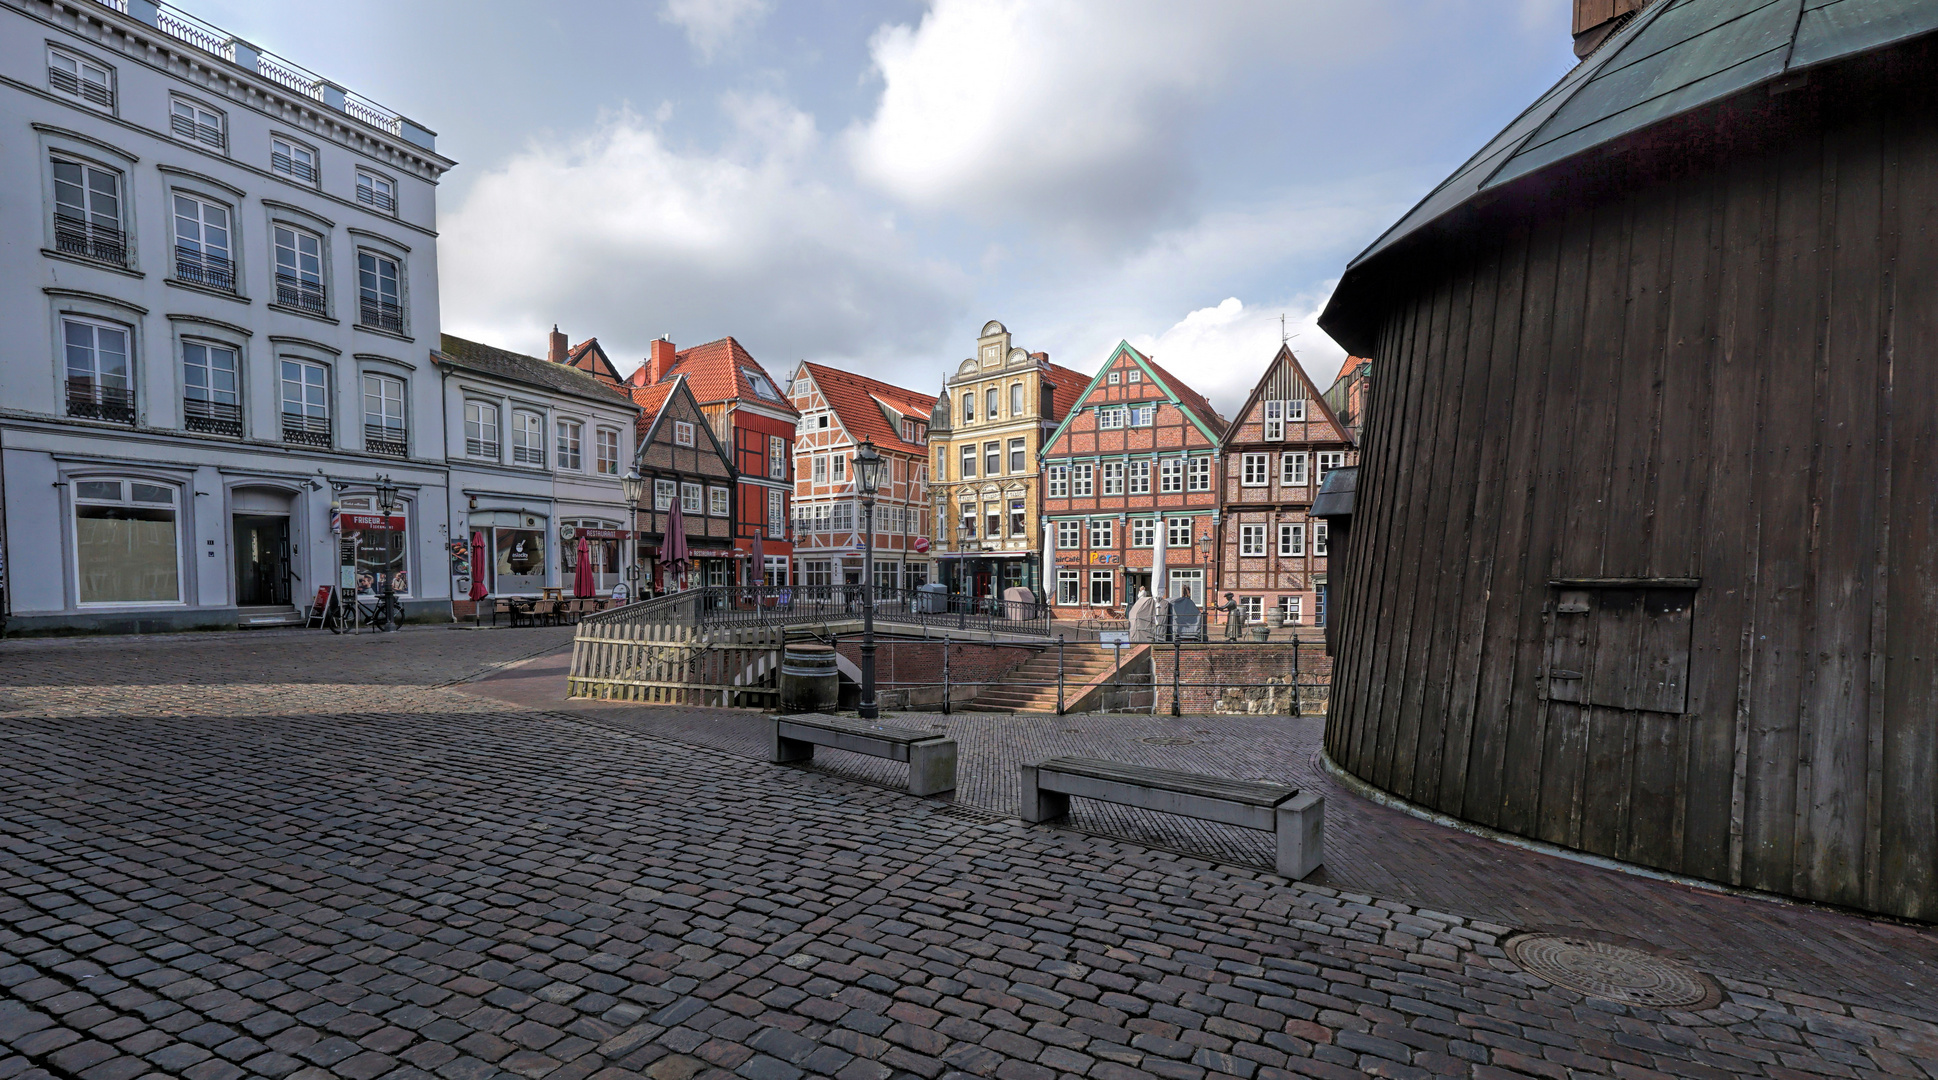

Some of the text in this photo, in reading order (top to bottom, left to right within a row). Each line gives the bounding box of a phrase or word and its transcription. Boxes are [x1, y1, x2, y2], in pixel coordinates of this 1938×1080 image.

[353, 516, 380, 524] FRISEUR
[586, 529, 616, 538] RESTAURANT
[1055, 552, 1120, 564] airCafé Pera
